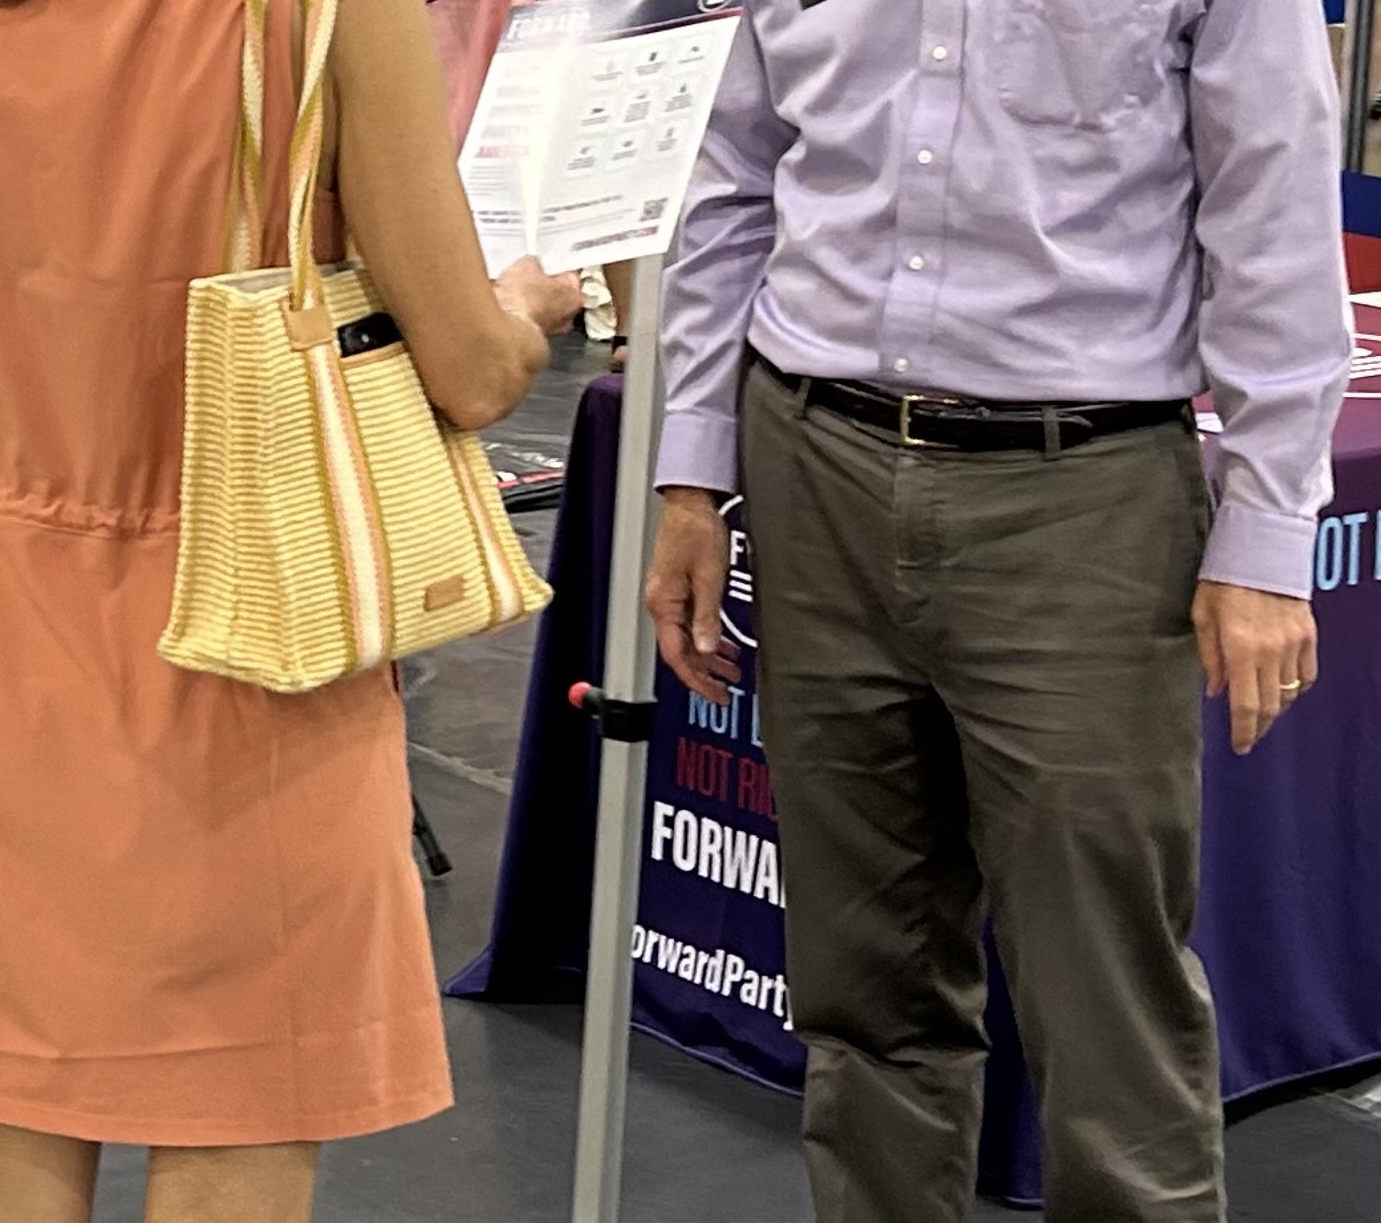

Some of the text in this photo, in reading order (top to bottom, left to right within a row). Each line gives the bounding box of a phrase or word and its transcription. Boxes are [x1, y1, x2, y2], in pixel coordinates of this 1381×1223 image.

[1317, 513, 1370, 591] OT
[676, 736, 734, 804] NOT
[650, 801, 786, 909] FORWA
